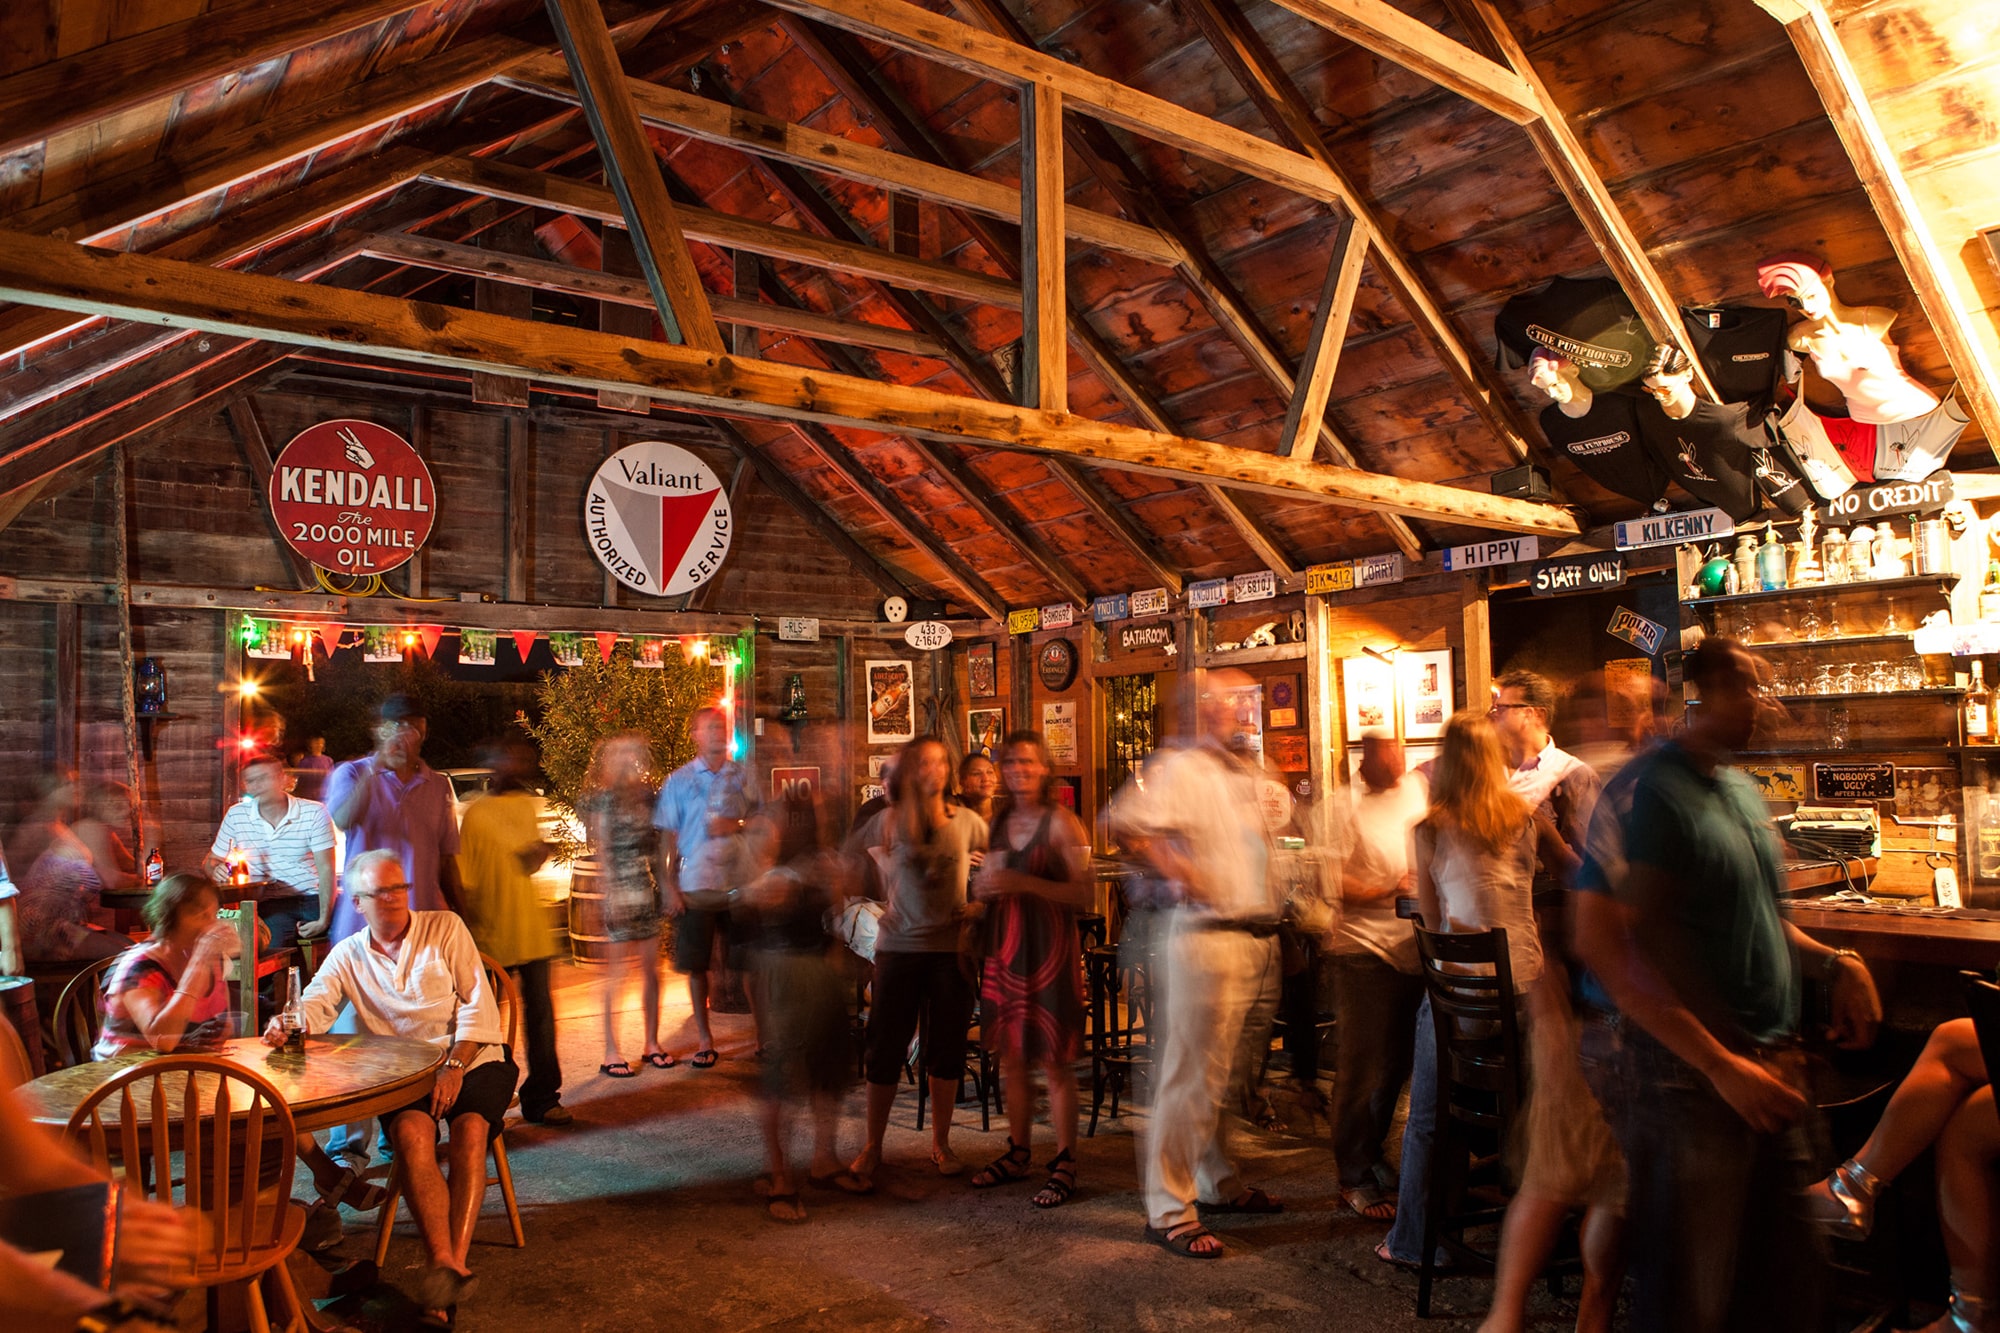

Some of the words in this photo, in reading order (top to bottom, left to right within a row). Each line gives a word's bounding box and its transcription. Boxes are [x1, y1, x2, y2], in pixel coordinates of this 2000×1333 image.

[1535, 330, 1555, 345] THE
[1558, 339, 1622, 363] PUMPHOUSE
[618, 458, 703, 491] Valiant
[280, 465, 429, 512] KENDALL
[1829, 493, 1860, 517] NO
[1869, 480, 1945, 512] CREDIT
[337, 511, 373, 525] The
[1642, 514, 1714, 542] KILKENNY
[292, 522, 362, 544] 2000
[367, 527, 415, 548] MILE
[589, 493, 647, 586] AUTHORIZED
[688, 508, 728, 583] SERVICE
[337, 548, 375, 567] OIL
[1465, 540, 1520, 564] HIPPY
[1362, 562, 1394, 581] LORRY
[1536, 565, 1582, 590] STAFF
[1589, 559, 1622, 583] ONLY
[914, 635, 943, 647] Z-1647
[921, 624, 936, 635] 433
[1122, 626, 1170, 647] BATHROOM
[1613, 612, 1657, 647] POLAR
[781, 777, 812, 800] NO
[1833, 772, 1877, 781] NOBODY'S
[1843, 781, 1867, 790] UGLY
